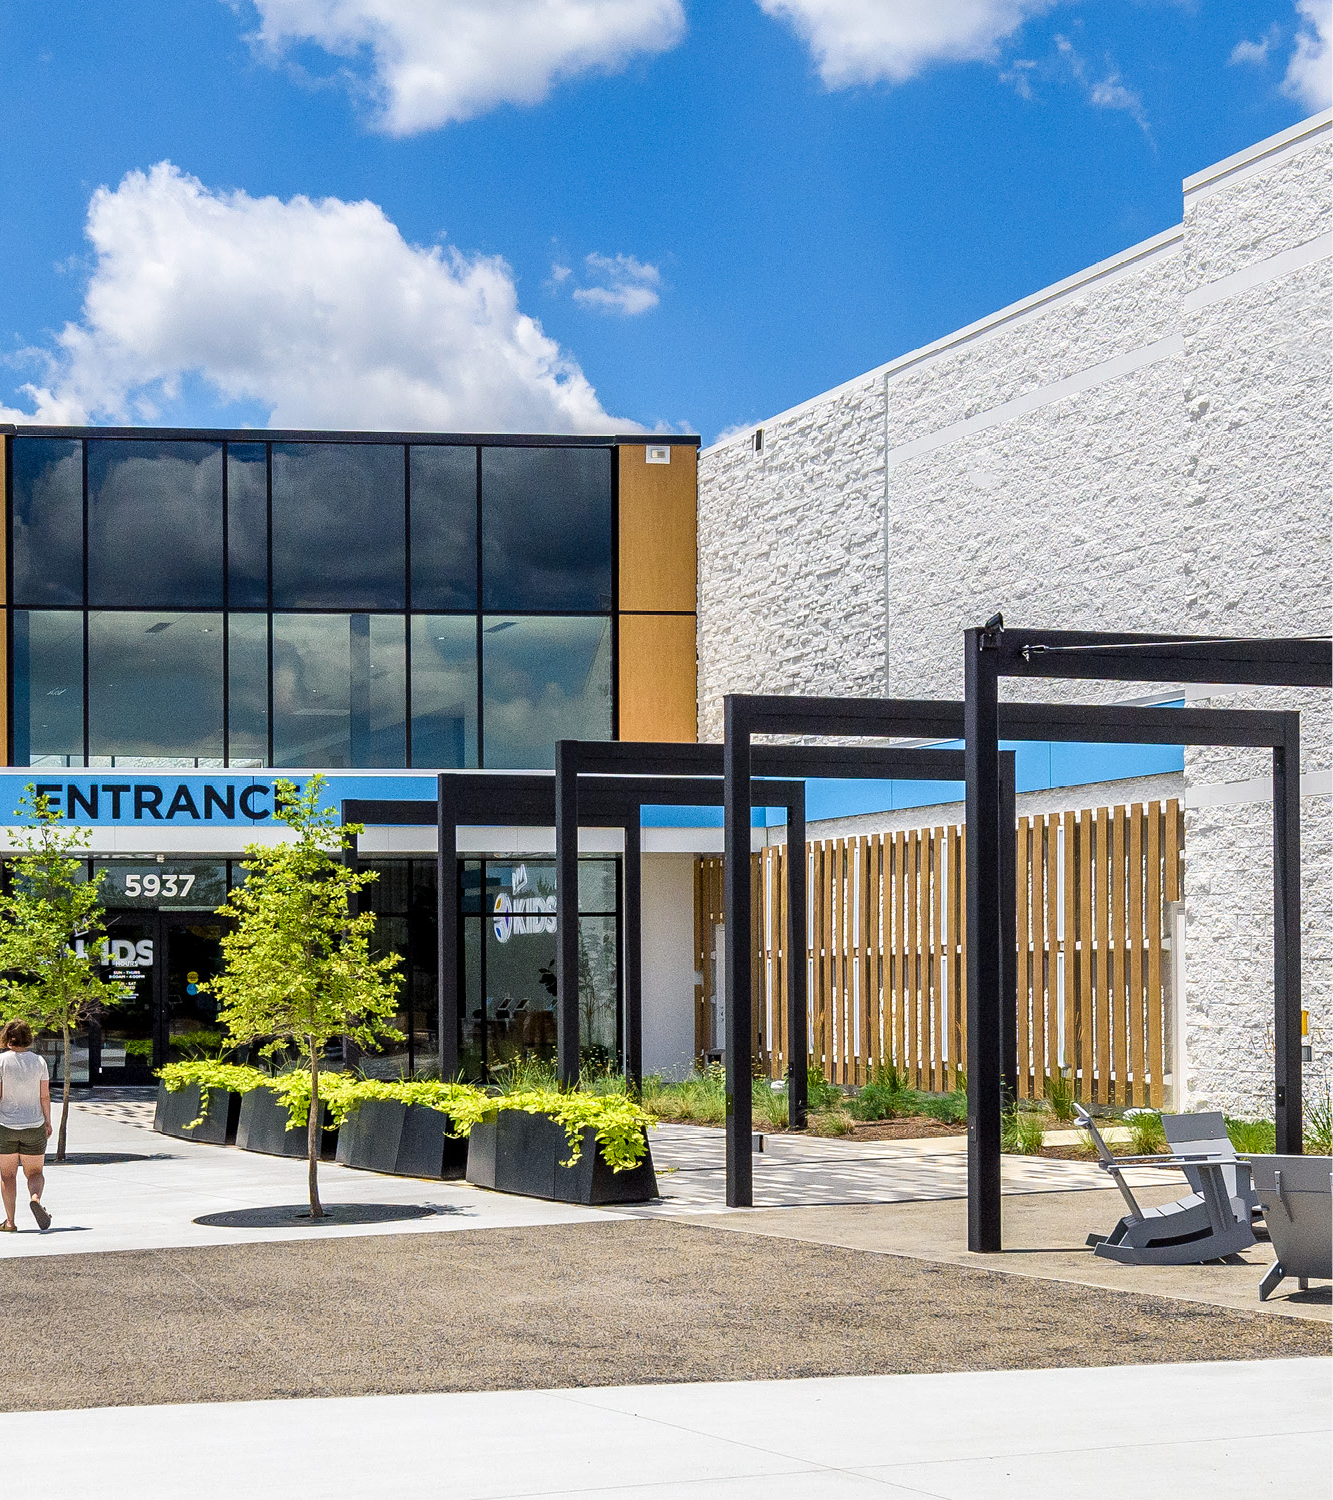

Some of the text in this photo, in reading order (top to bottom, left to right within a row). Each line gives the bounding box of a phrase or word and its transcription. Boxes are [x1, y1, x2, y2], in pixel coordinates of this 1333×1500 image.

[37, 784, 301, 820] ENTRANCE
[125, 874, 196, 897] 5937
[513, 895, 557, 934] KIDS
